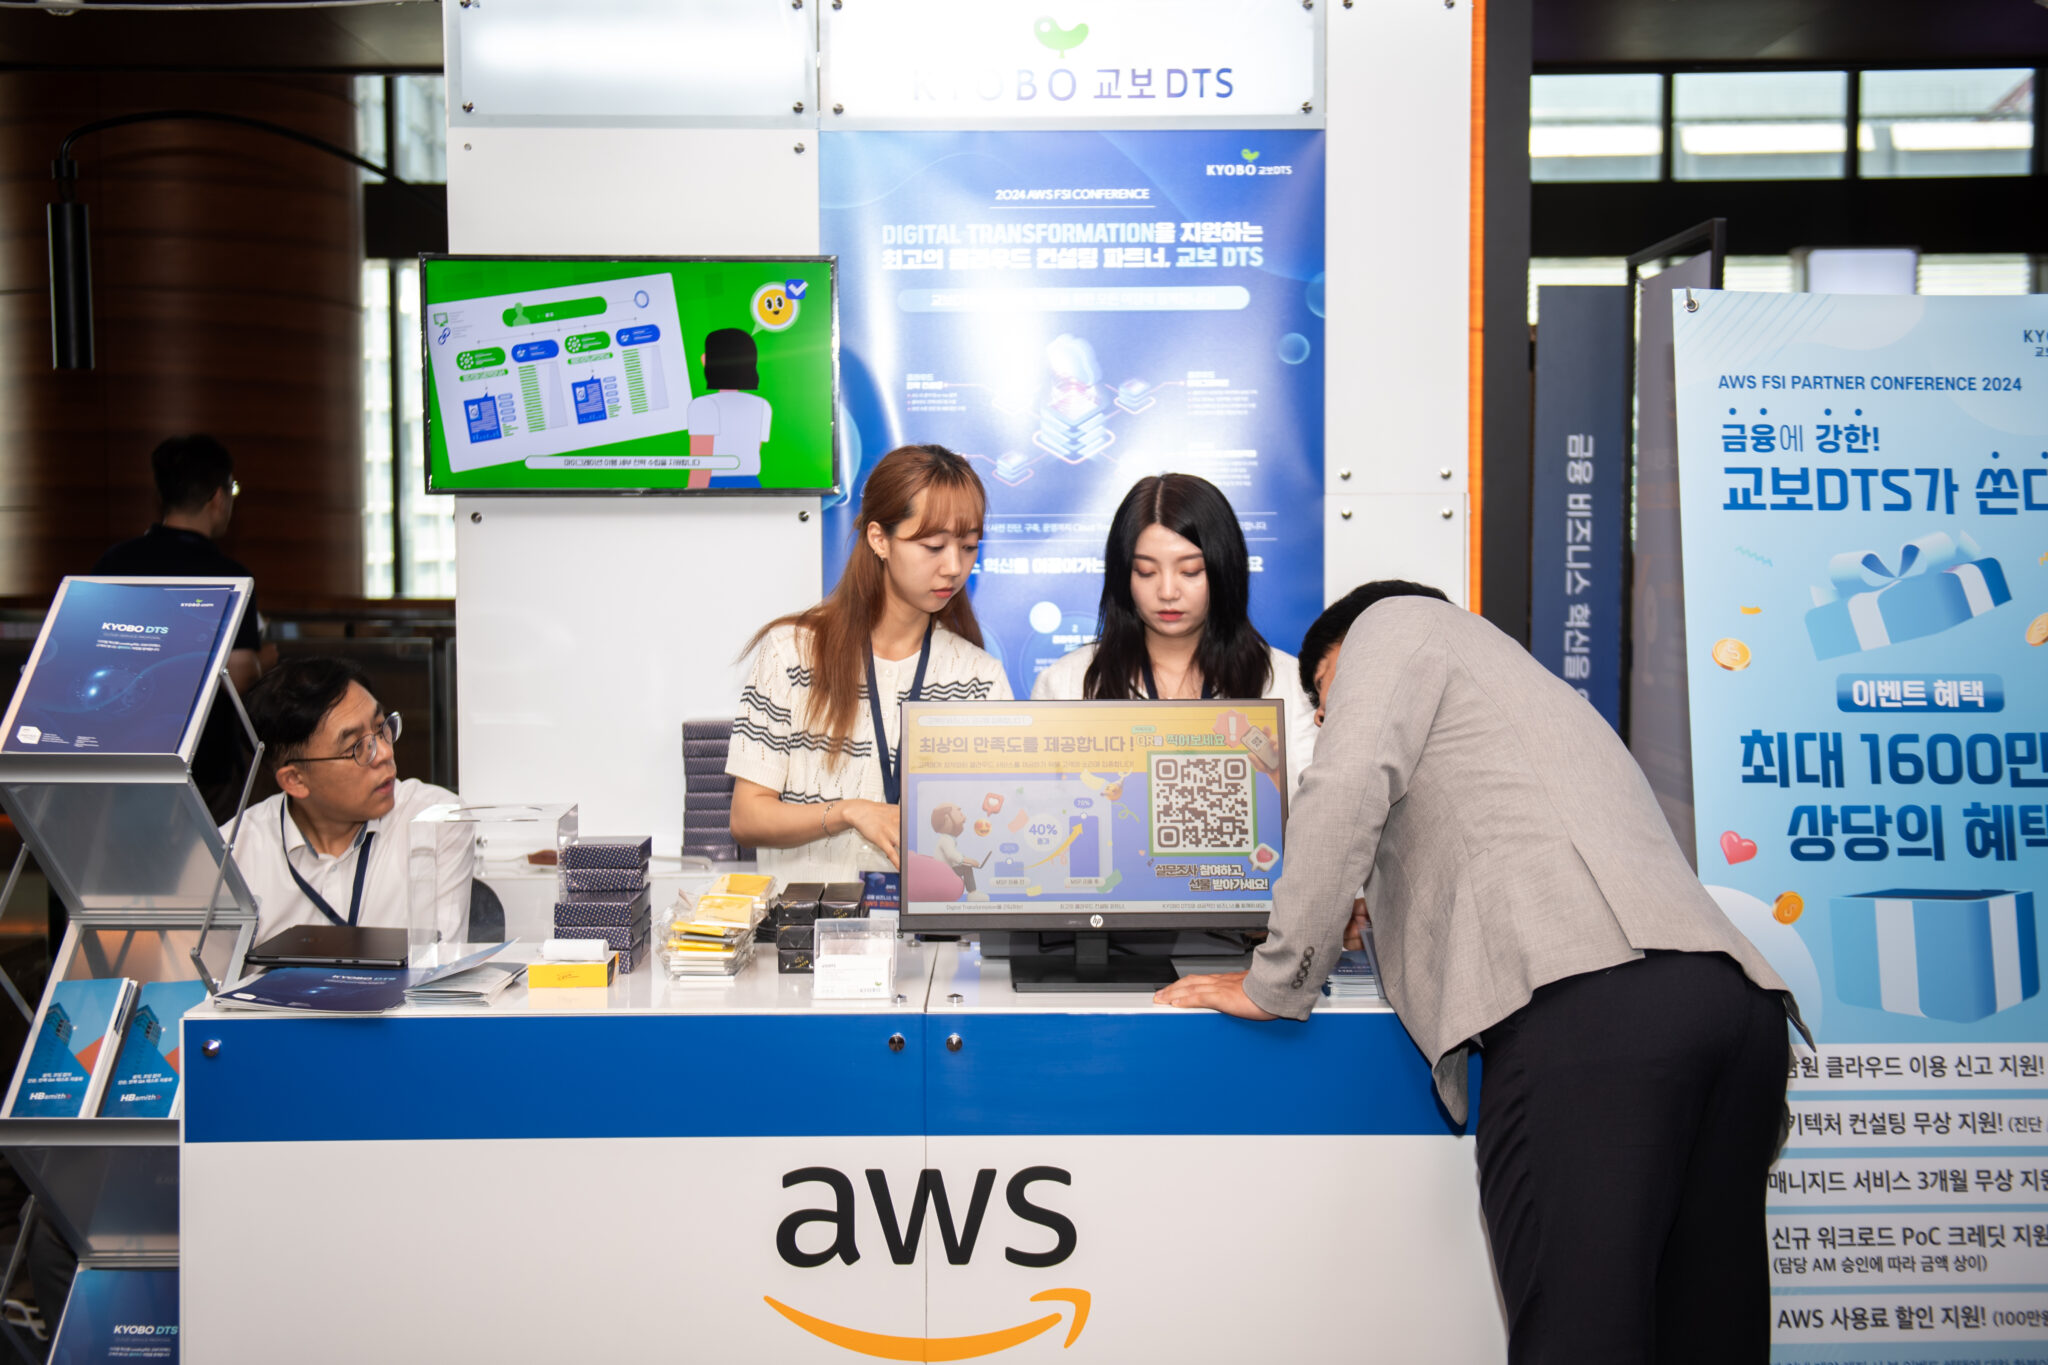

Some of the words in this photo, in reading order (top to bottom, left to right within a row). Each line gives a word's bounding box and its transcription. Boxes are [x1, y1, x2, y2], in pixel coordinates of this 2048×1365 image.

[1206, 164, 1256, 176] KYOBO
[995, 190, 1026, 200] 2024
[1027, 189, 1054, 200] AWS
[1055, 189, 1071, 199] FSI
[1073, 188, 1150, 199] CONFERENCE
[882, 223, 961, 246] DIGITAL
[1180, 221, 1263, 244] 지원하는
[881, 248, 943, 270] 최고의
[1175, 246, 1218, 268] 교보
[1222, 246, 1263, 267] DTS
[2023, 329, 2048, 343] KY
[2035, 346, 2048, 357] 교
[1718, 375, 1757, 391] AWS
[1761, 375, 1786, 391] FSI
[1791, 375, 1866, 391] PARTNER
[1869, 375, 1977, 392] CONFERENCE
[1982, 376, 2022, 392] 2024
[1721, 423, 1804, 453] 금융에
[1815, 423, 1880, 454] 강한!
[1566, 432, 1595, 485] 금융
[1722, 466, 1960, 515] 교보DTS가
[1564, 492, 1593, 596] 비즈니스
[101, 622, 144, 633] KYOBO
[145, 625, 168, 635] DTS
[1562, 602, 1592, 681] 혁신을
[1851, 679, 1928, 708] 이벤트
[1933, 678, 1985, 708] 혜택
[919, 736, 969, 753] 최상의
[973, 736, 1039, 753] 만족도를
[1043, 736, 1126, 752] 제공합니다
[1166, 733, 1226, 747] 찍어보세요
[1740, 729, 1845, 788] 최대
[1028, 824, 1058, 836] 40%
[1787, 804, 1946, 862] 상당의
[1200, 864, 1245, 878] 참여하고,
[1188, 878, 1212, 892] 선물
[1212, 878, 1269, 891] 받아가세요!
[1091, 914, 1103, 928] hp
[1825, 1055, 1904, 1078] 클라우드
[1908, 1055, 1948, 1078] 이용
[1954, 1055, 1994, 1078] 신고
[1999, 1054, 2045, 1078] 지원!
[29, 1092, 66, 1100] HBsmith
[120, 1093, 156, 1102] HBsmith
[1848, 1112, 1907, 1136] 컨설팅
[1913, 1112, 1952, 1135] 무상
[1957, 1111, 2003, 1135] 지원!
[2008, 1116, 2042, 1134] (진단
[1768, 1170, 1847, 1194] 매니지드
[1853, 1170, 1912, 1194] 서비스
[1917, 1169, 1968, 1193] 3개월
[1974, 1169, 2014, 1193] 무상
[776, 1165, 1077, 1268] aws
[1772, 1227, 1811, 1250] 신규
[1817, 1226, 1896, 1250] 워크로드
[1902, 1228, 1941, 1246] PoC
[1947, 1224, 2006, 1249] 크레딧
[1774, 1257, 1807, 1275] (담당
[1812, 1258, 1836, 1272] AM
[1841, 1256, 1883, 1274] 승인에
[1888, 1256, 1916, 1273] 따라
[1920, 1255, 1949, 1273] 금액
[1953, 1254, 1988, 1273] 상이)
[1777, 1309, 1824, 1328] AWS
[1830, 1307, 1890, 1330] 사용료
[1895, 1306, 1935, 1330] 할인
[1940, 1305, 1987, 1329] 지원!
[113, 1325, 155, 1334] KYOBO
[155, 1326, 178, 1335] DTS
